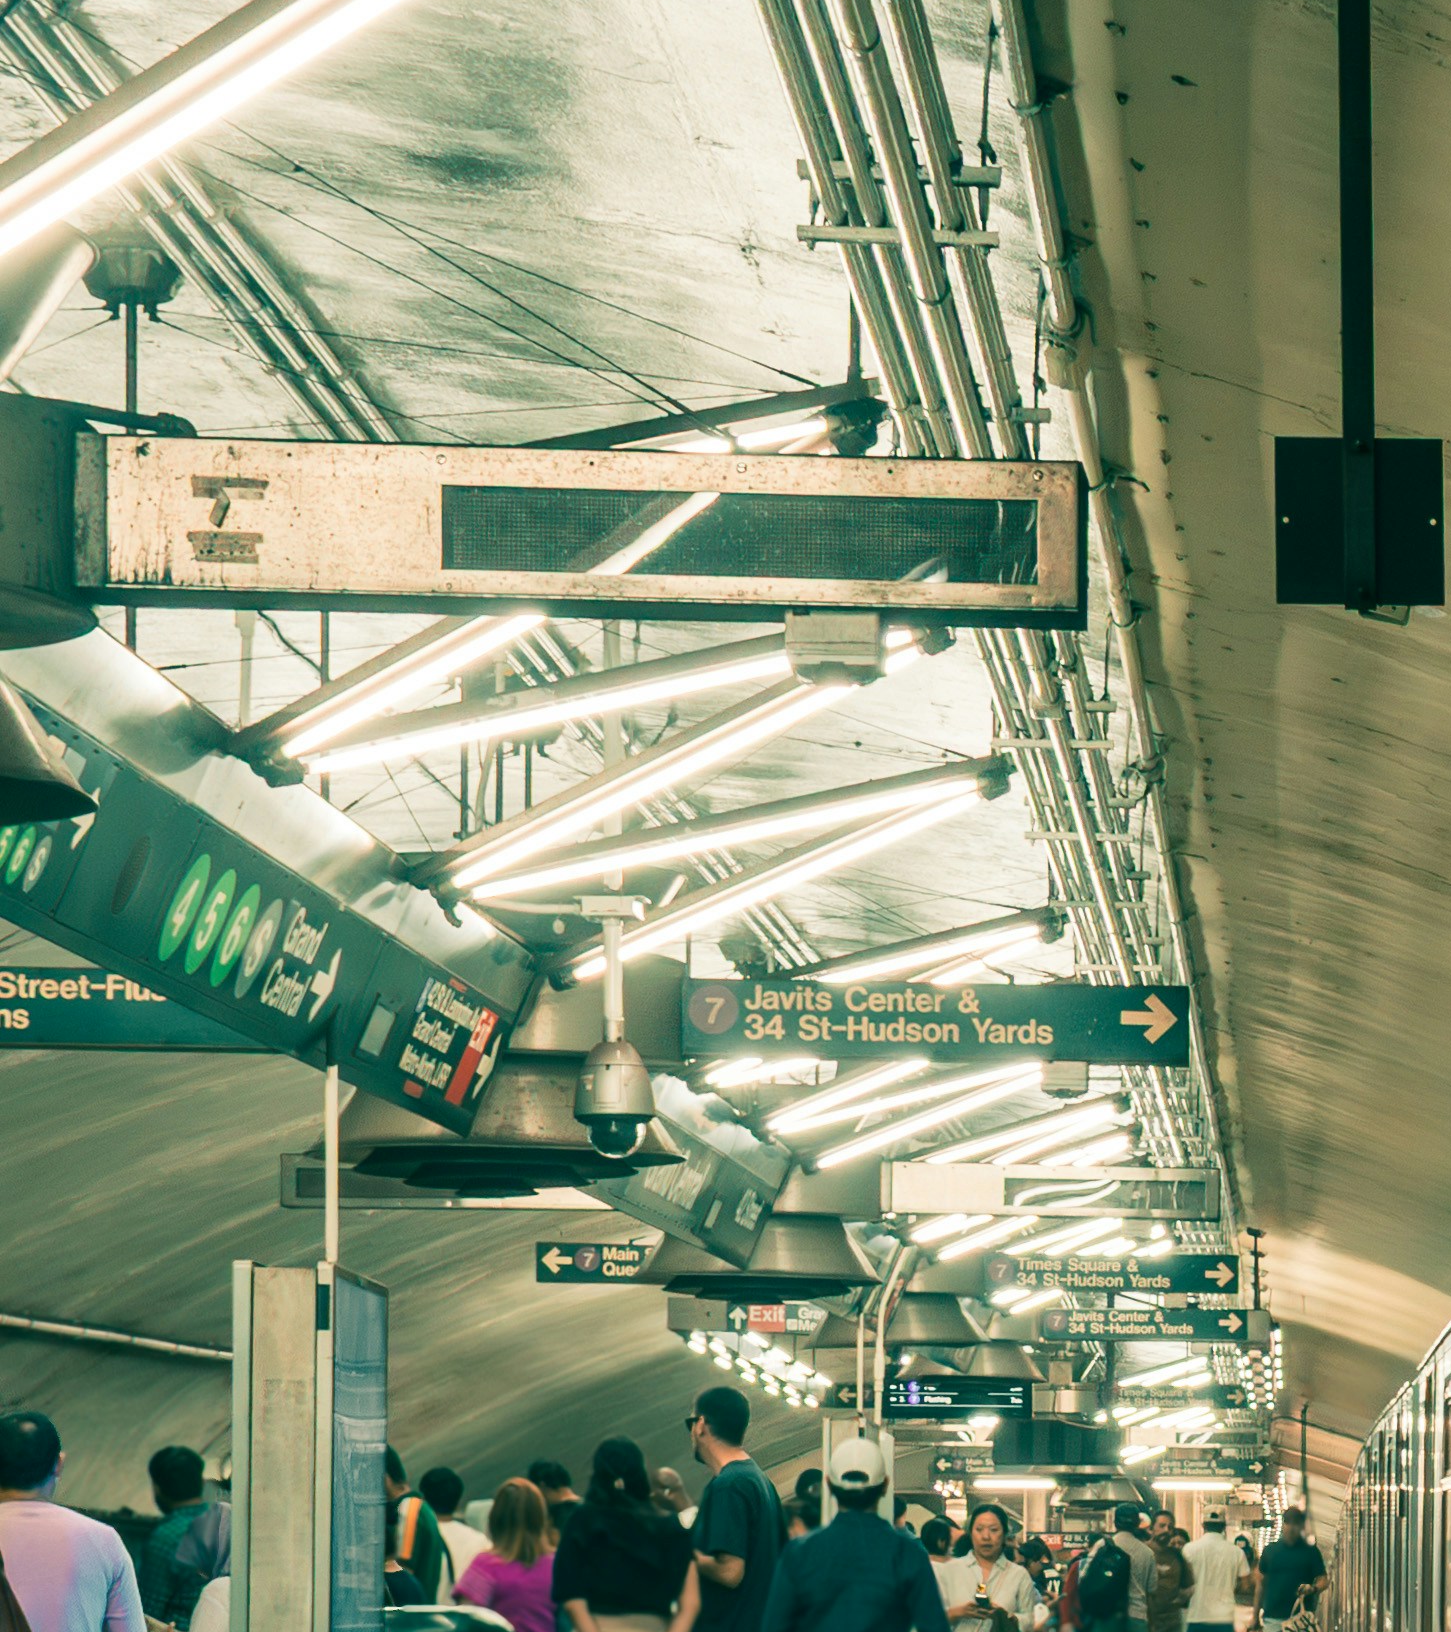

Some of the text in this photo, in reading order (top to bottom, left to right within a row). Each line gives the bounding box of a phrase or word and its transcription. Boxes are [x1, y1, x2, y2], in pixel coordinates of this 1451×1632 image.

[172, 878, 274, 978] 4 5 6 S
[282, 906, 329, 965] Grand
[260, 957, 313, 1018] Central
[744, 984, 980, 1014] Javits Center &
[704, 997, 726, 1025] 7
[744, 1014, 1054, 1045] 34 St-Hudson Yards
[583, 1252, 595, 1267] 7
[602, 1246, 639, 1261] Main
[997, 1264, 1007, 1278] 7
[1017, 1258, 1138, 1273] Times Square &
[1017, 1273, 1171, 1288] 34 St-Hudson Yards
[749, 1306, 785, 1323] Exit
[1053, 1316, 1061, 1327] 7
[1068, 1311, 1164, 1322] Javits Center &
[1068, 1322, 1194, 1335] 34 St-Hudson Yards
